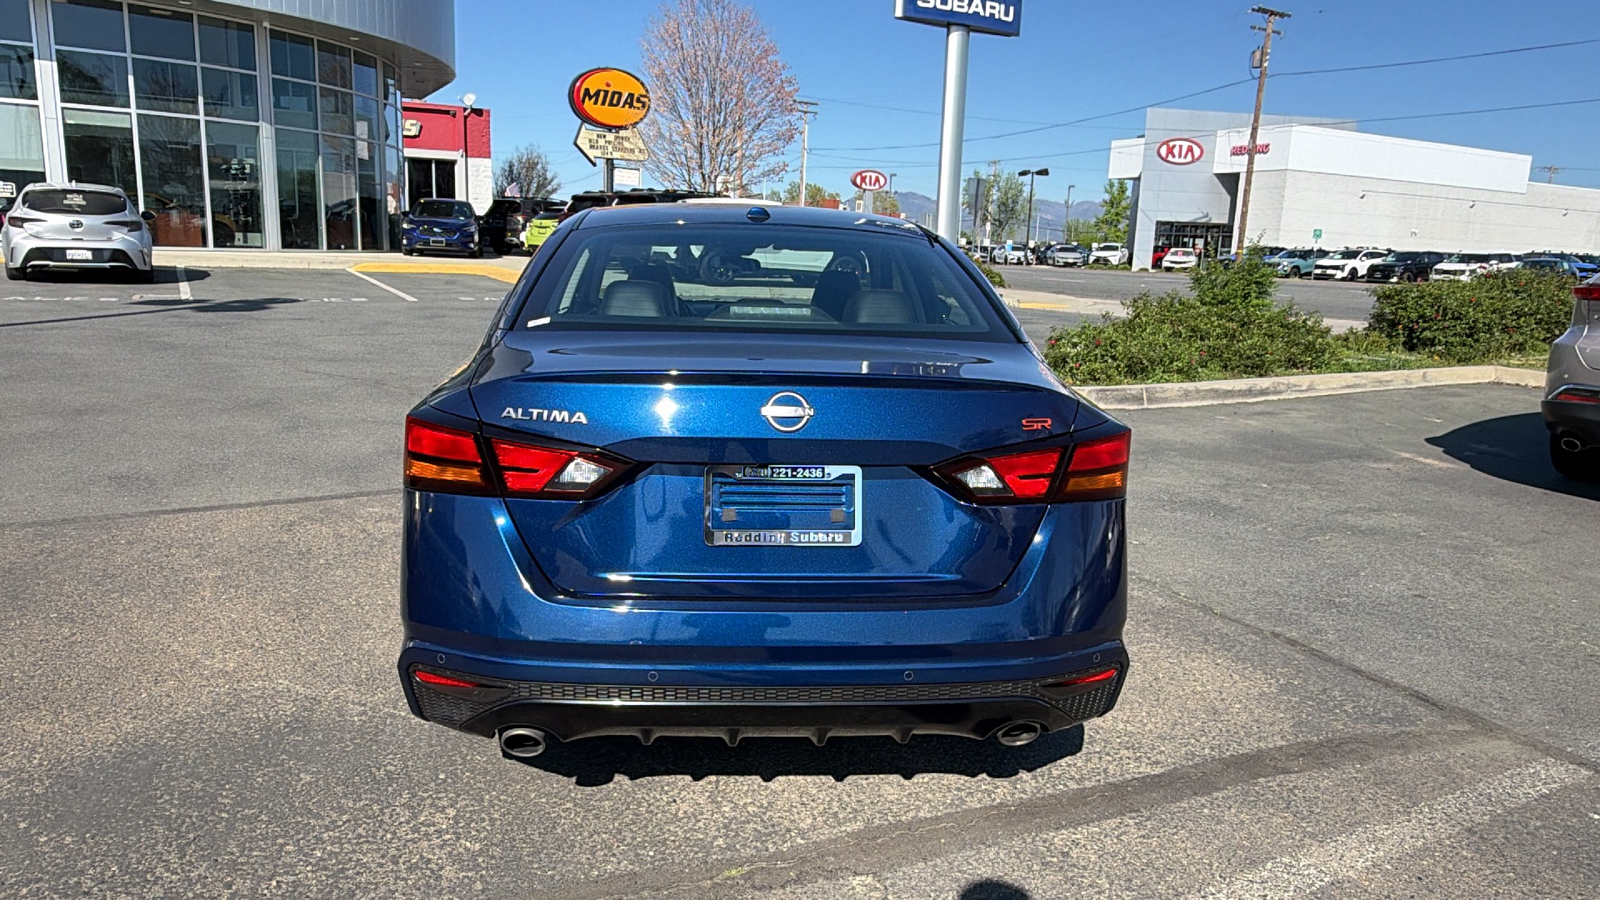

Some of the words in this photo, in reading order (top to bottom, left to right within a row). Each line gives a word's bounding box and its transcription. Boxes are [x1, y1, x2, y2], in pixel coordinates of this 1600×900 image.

[917, 0, 1014, 22] SUBARU
[581, 82, 648, 110] MIDAS
[1164, 143, 1196, 161] KIA
[1230, 143, 1271, 156] REDNG
[860, 173, 882, 188] KIA
[501, 407, 588, 424] ALTIMA
[1021, 417, 1052, 430] SR
[772, 467, 823, 478] 221-2436
[790, 532, 843, 543] Subaru
